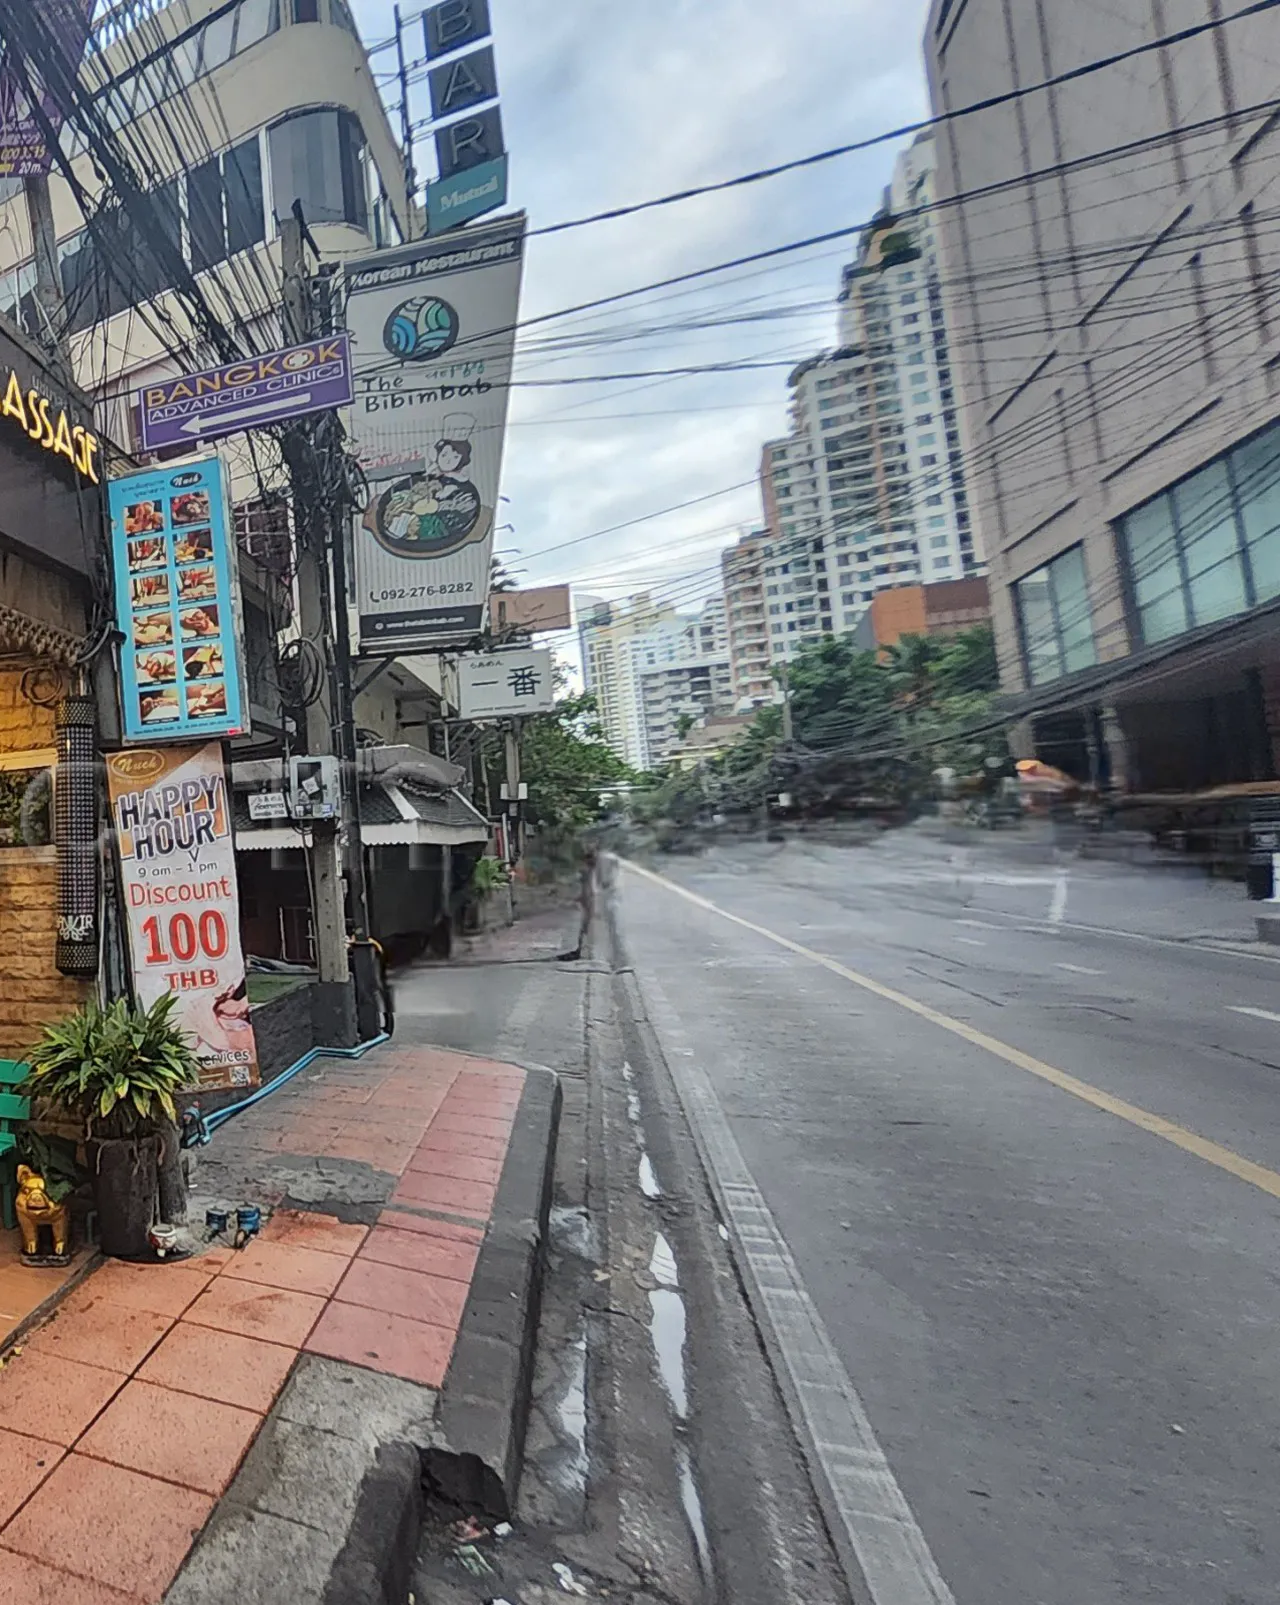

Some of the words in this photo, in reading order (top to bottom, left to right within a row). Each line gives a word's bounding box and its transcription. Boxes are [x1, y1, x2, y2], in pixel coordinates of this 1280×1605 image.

[436, 0, 487, 165] BAR
[146, 340, 343, 408] BANGKOK
[362, 375, 404, 393] The
[151, 386, 257, 420] ADVANCED
[365, 378, 492, 413] Bibimbab
[380, 582, 474, 600] 092-276-8282
[118, 775, 219, 832] HAPPY
[132, 811, 216, 861] HOUR
[138, 867, 147, 878] 9
[152, 868, 171, 877] am
[199, 862, 218, 873] pm
[130, 876, 231, 906] Discount
[142, 910, 228, 964] 100
[165, 969, 218, 990] THB
[200, 1050, 250, 1067] ervices
